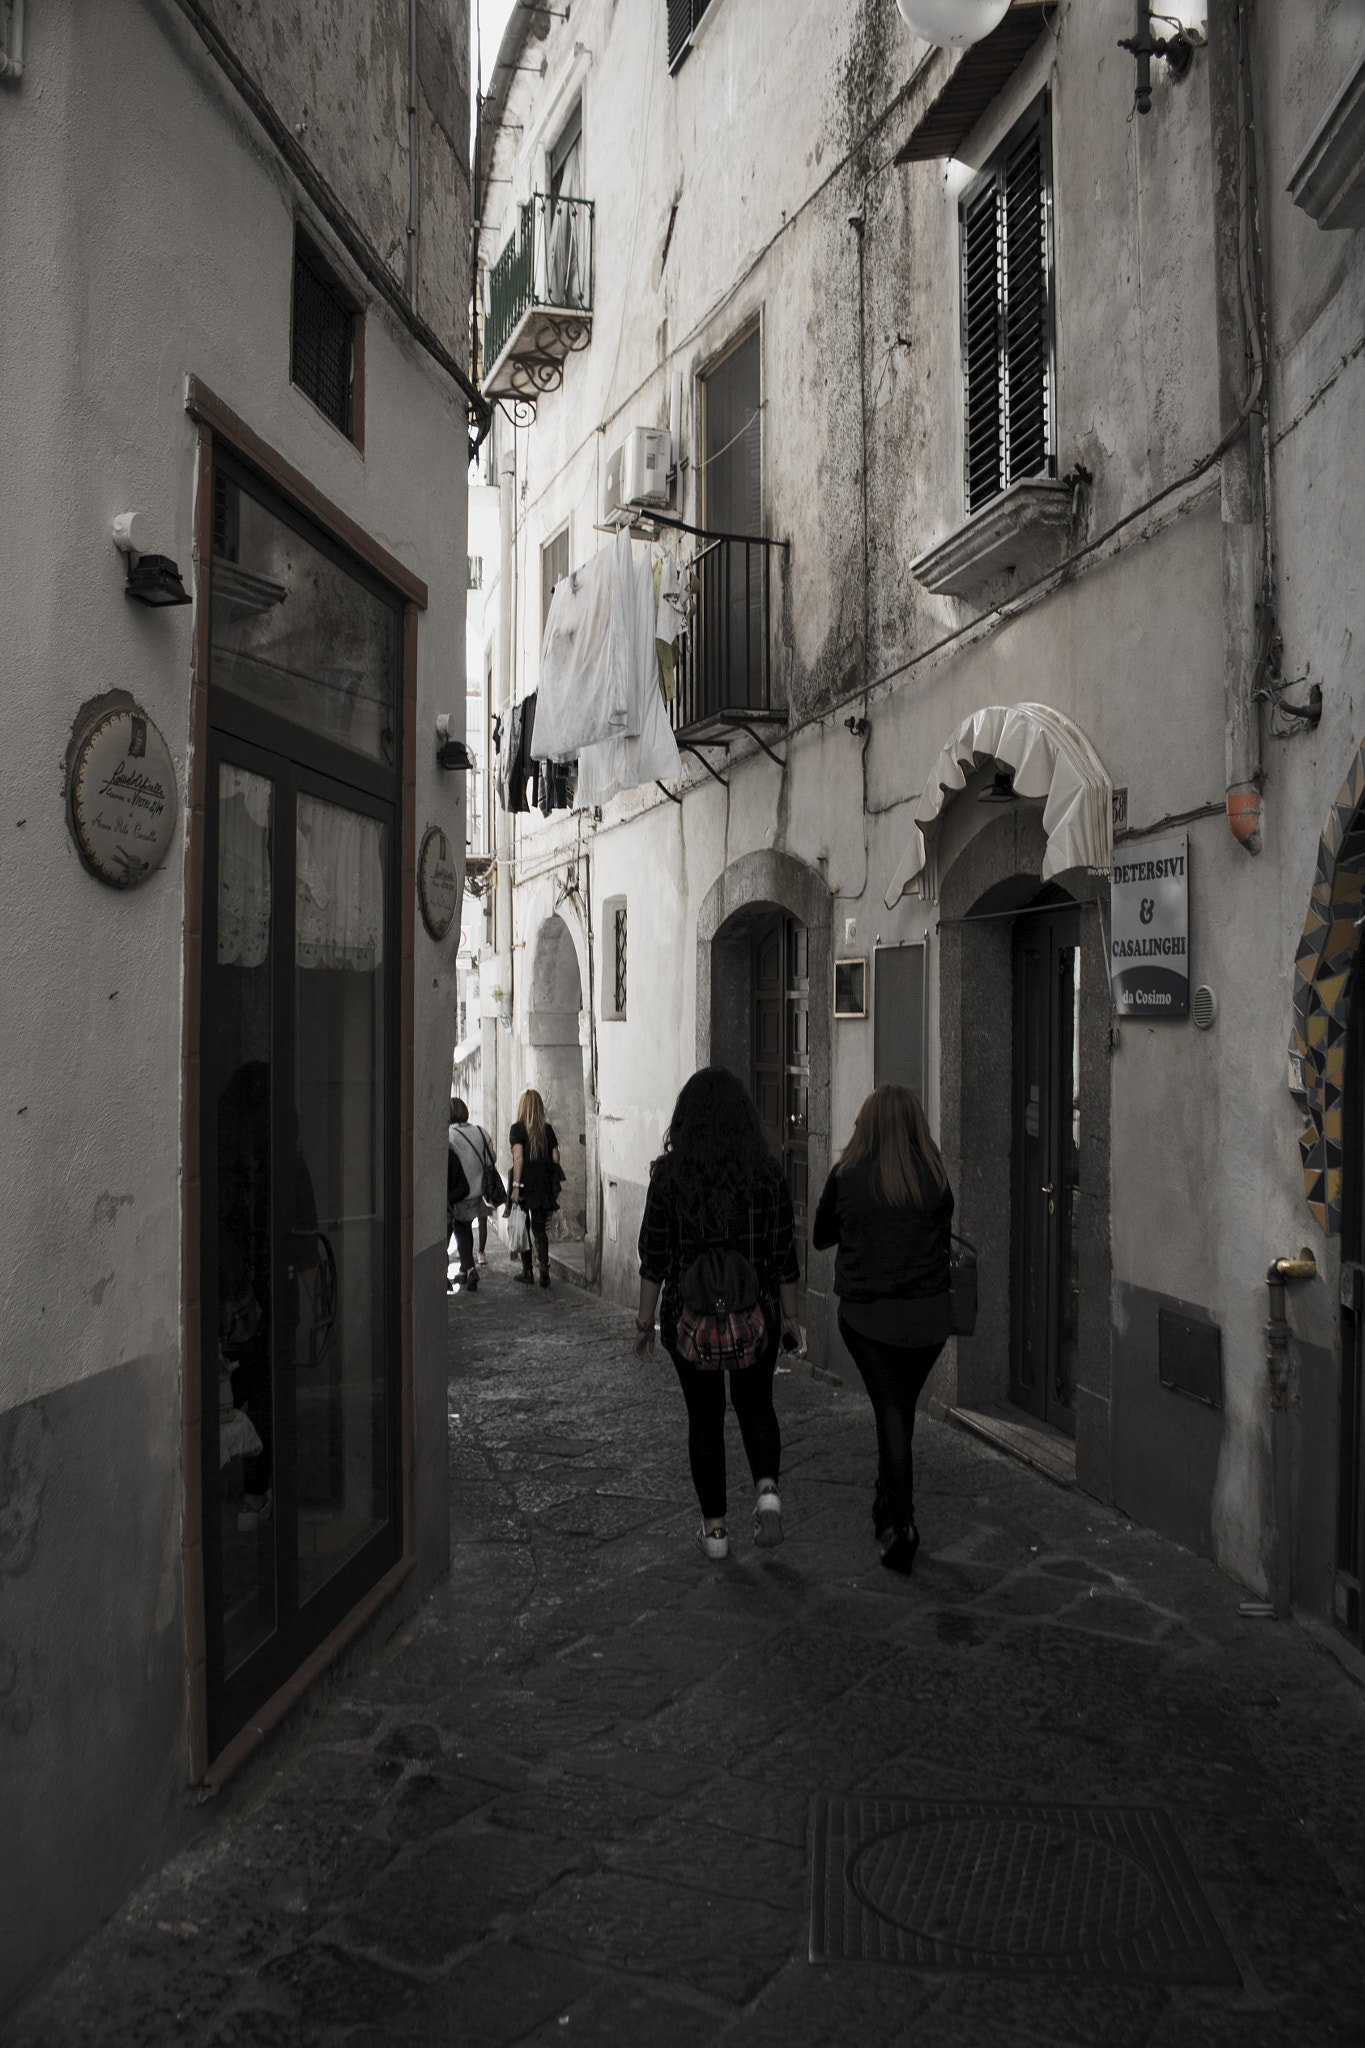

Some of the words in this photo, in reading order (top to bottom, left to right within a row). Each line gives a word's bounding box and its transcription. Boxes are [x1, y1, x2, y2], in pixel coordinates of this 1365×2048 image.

[1113, 856, 1185, 885] DETERSIVI
[1140, 898, 1154, 925] &
[1112, 936, 1185, 957] CASALINGHI
[1122, 989, 1134, 1004] da
[1135, 989, 1171, 1005] Cosimo
